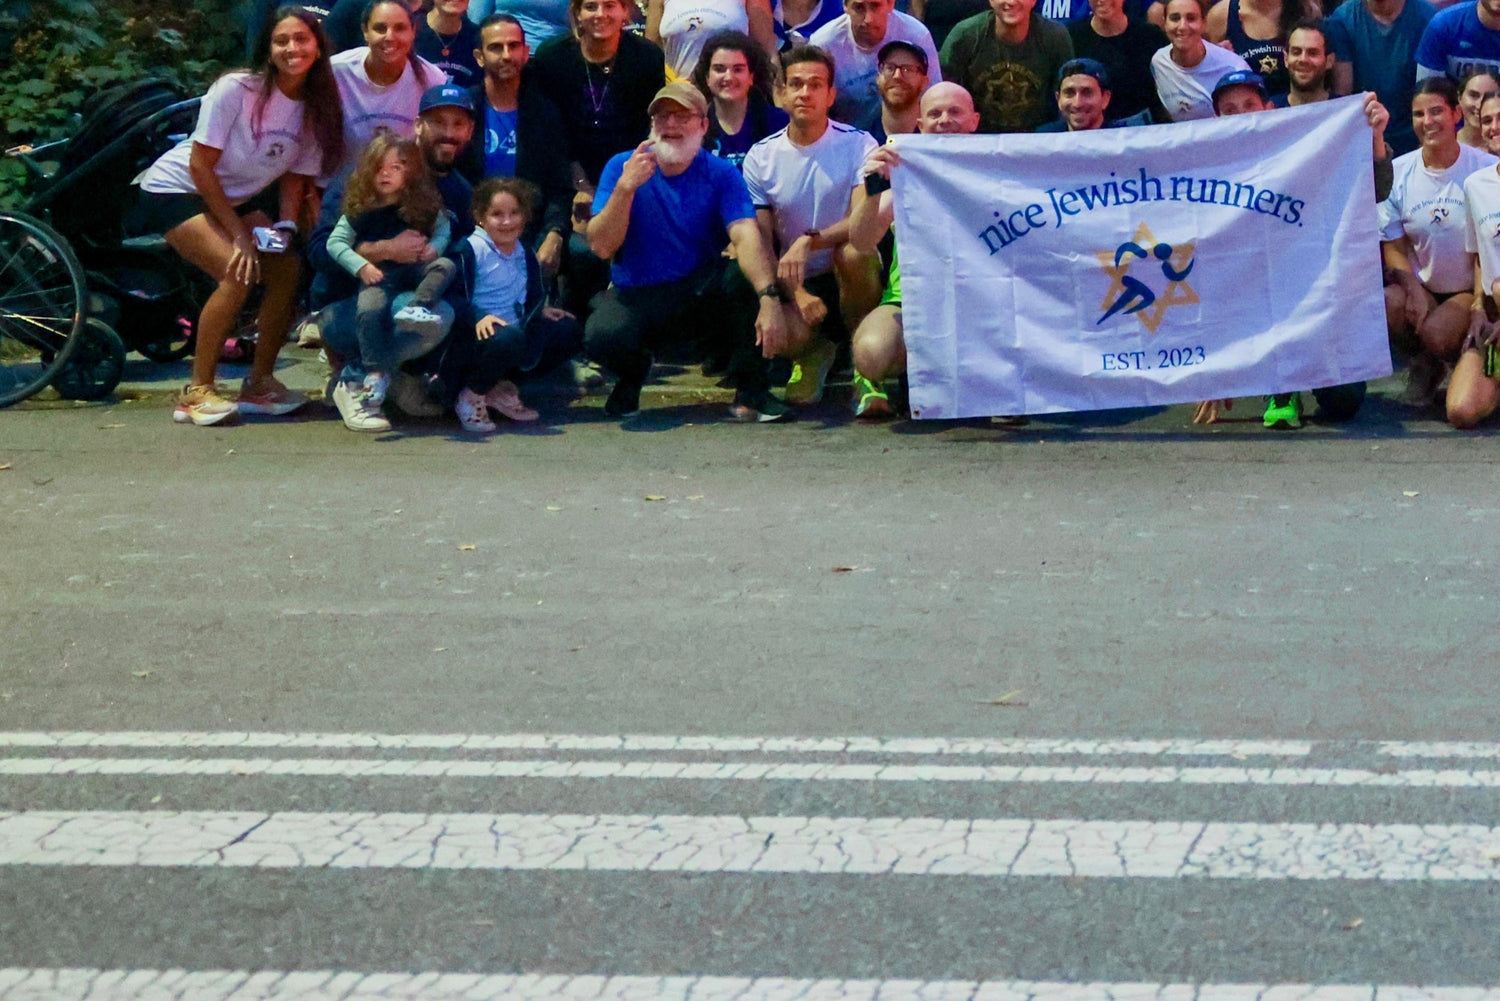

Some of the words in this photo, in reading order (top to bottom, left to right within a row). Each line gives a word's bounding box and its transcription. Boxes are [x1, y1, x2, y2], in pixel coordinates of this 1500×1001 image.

[977, 201, 1048, 256] nice
[1045, 167, 1166, 229] Jewish
[1102, 351, 1152, 371] EST.
[1157, 345, 1206, 369] 2023
